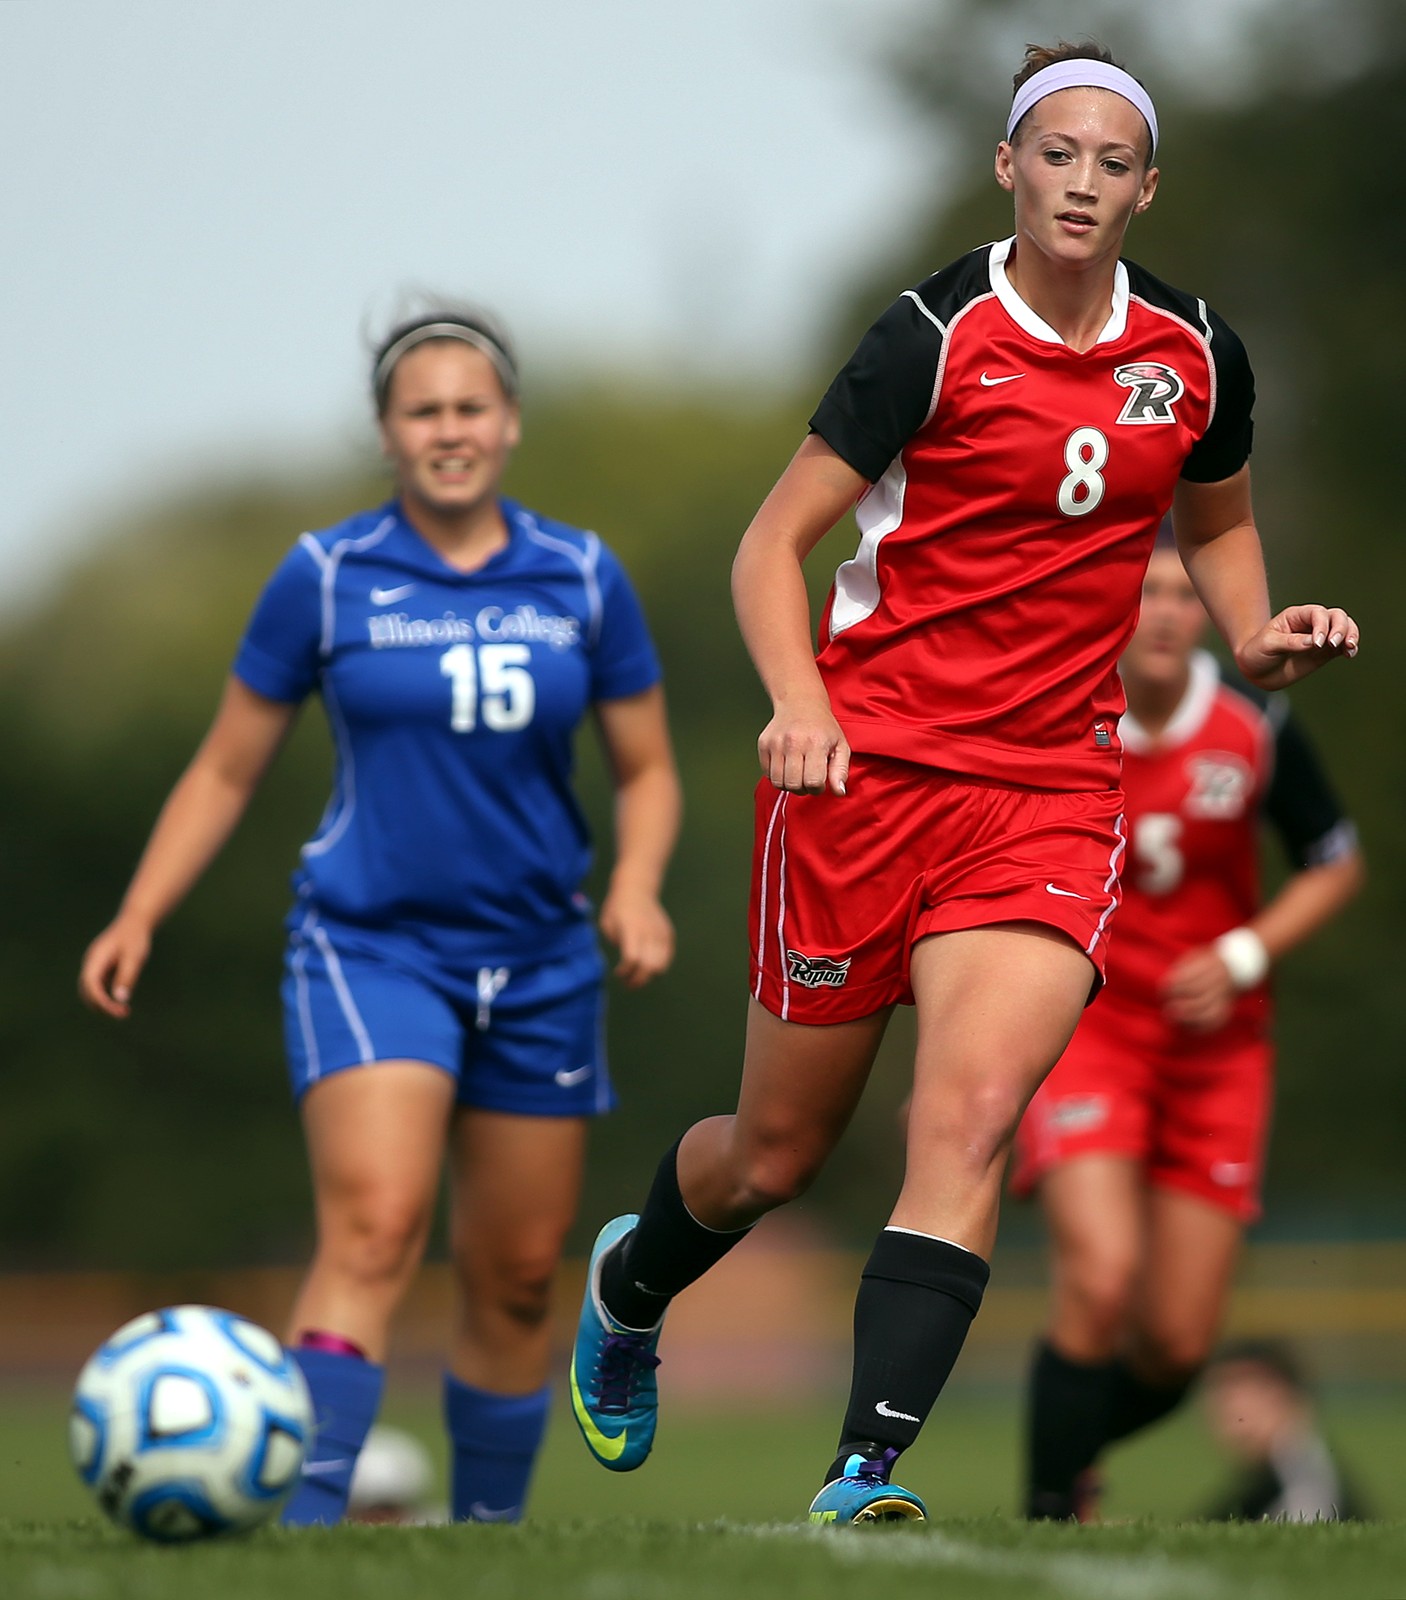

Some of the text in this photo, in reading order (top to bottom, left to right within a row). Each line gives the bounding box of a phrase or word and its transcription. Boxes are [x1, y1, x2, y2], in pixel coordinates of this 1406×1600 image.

[1113, 362, 1185, 425] R
[1057, 426, 1110, 518] 8
[476, 605, 580, 651] College
[440, 643, 536, 733] 15
[1134, 812, 1185, 895] 5
[787, 951, 850, 988] Ripon
